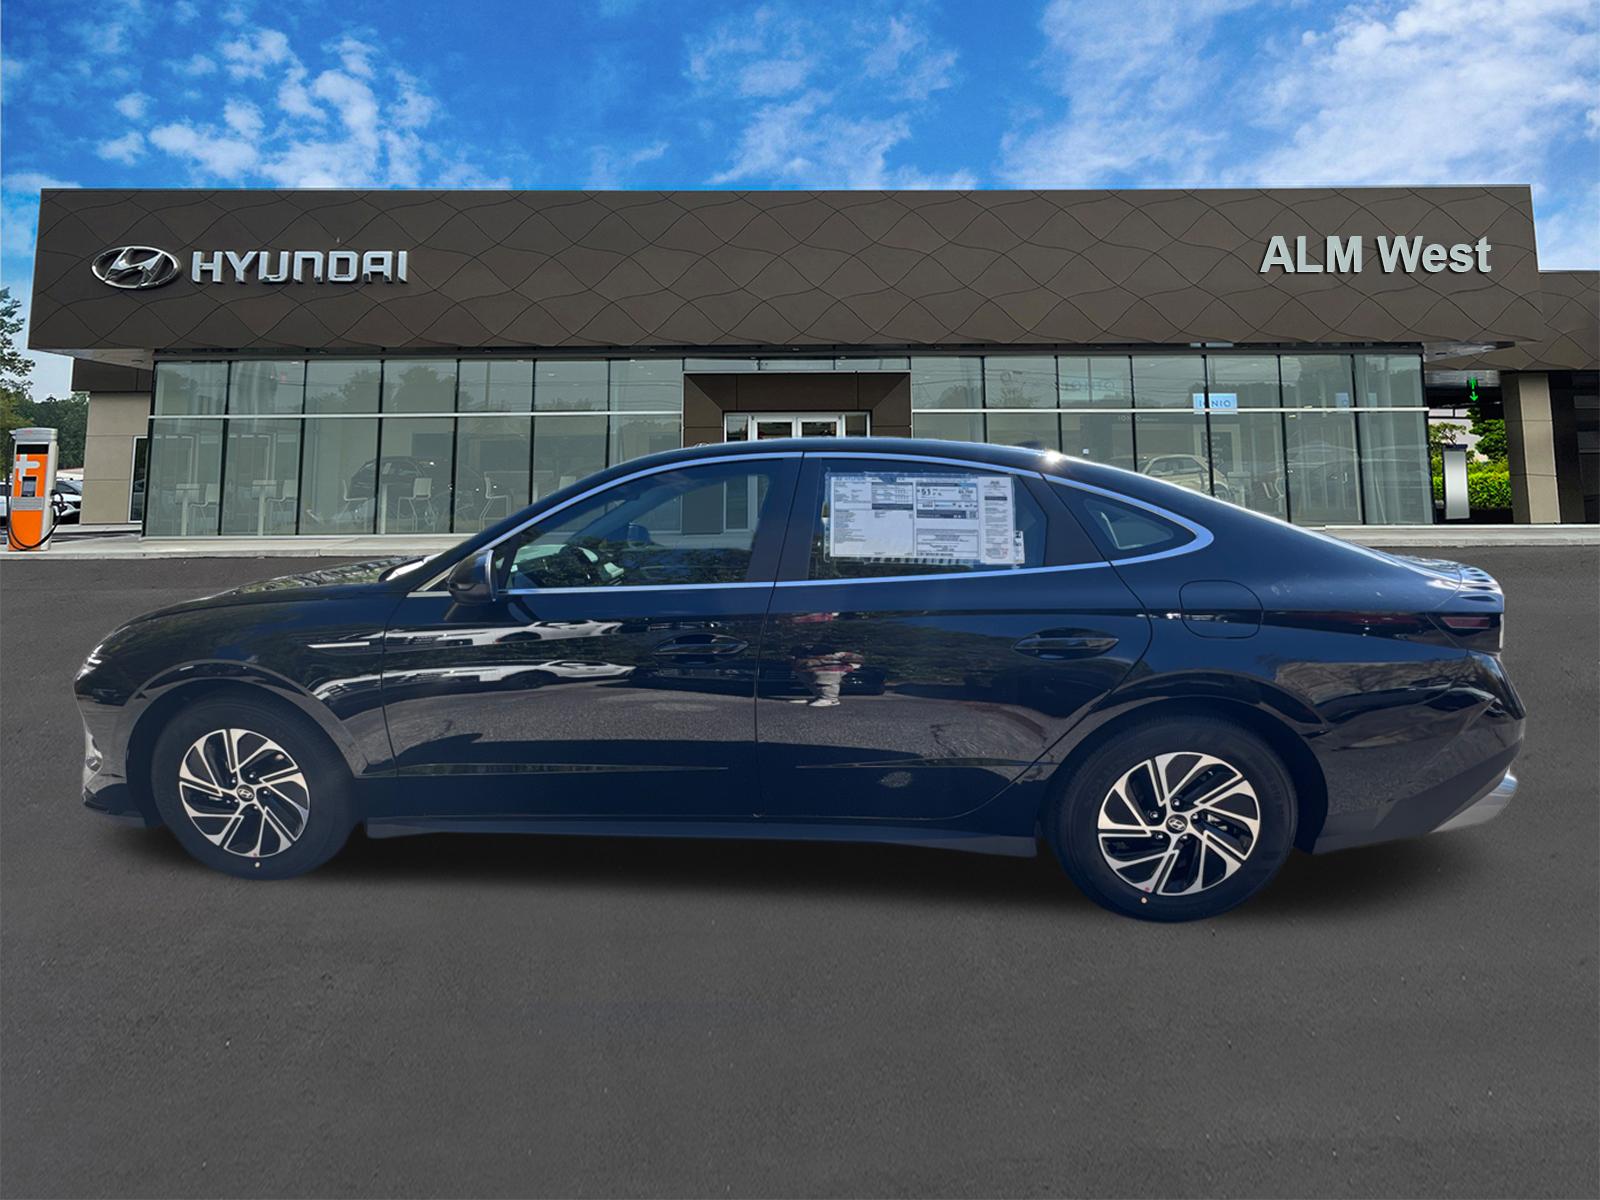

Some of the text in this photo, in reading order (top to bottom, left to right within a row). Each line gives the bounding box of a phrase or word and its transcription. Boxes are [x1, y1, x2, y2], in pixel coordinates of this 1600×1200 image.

[192, 250, 408, 284] HYUNDAI
[1260, 235, 1492, 273] ALM West
